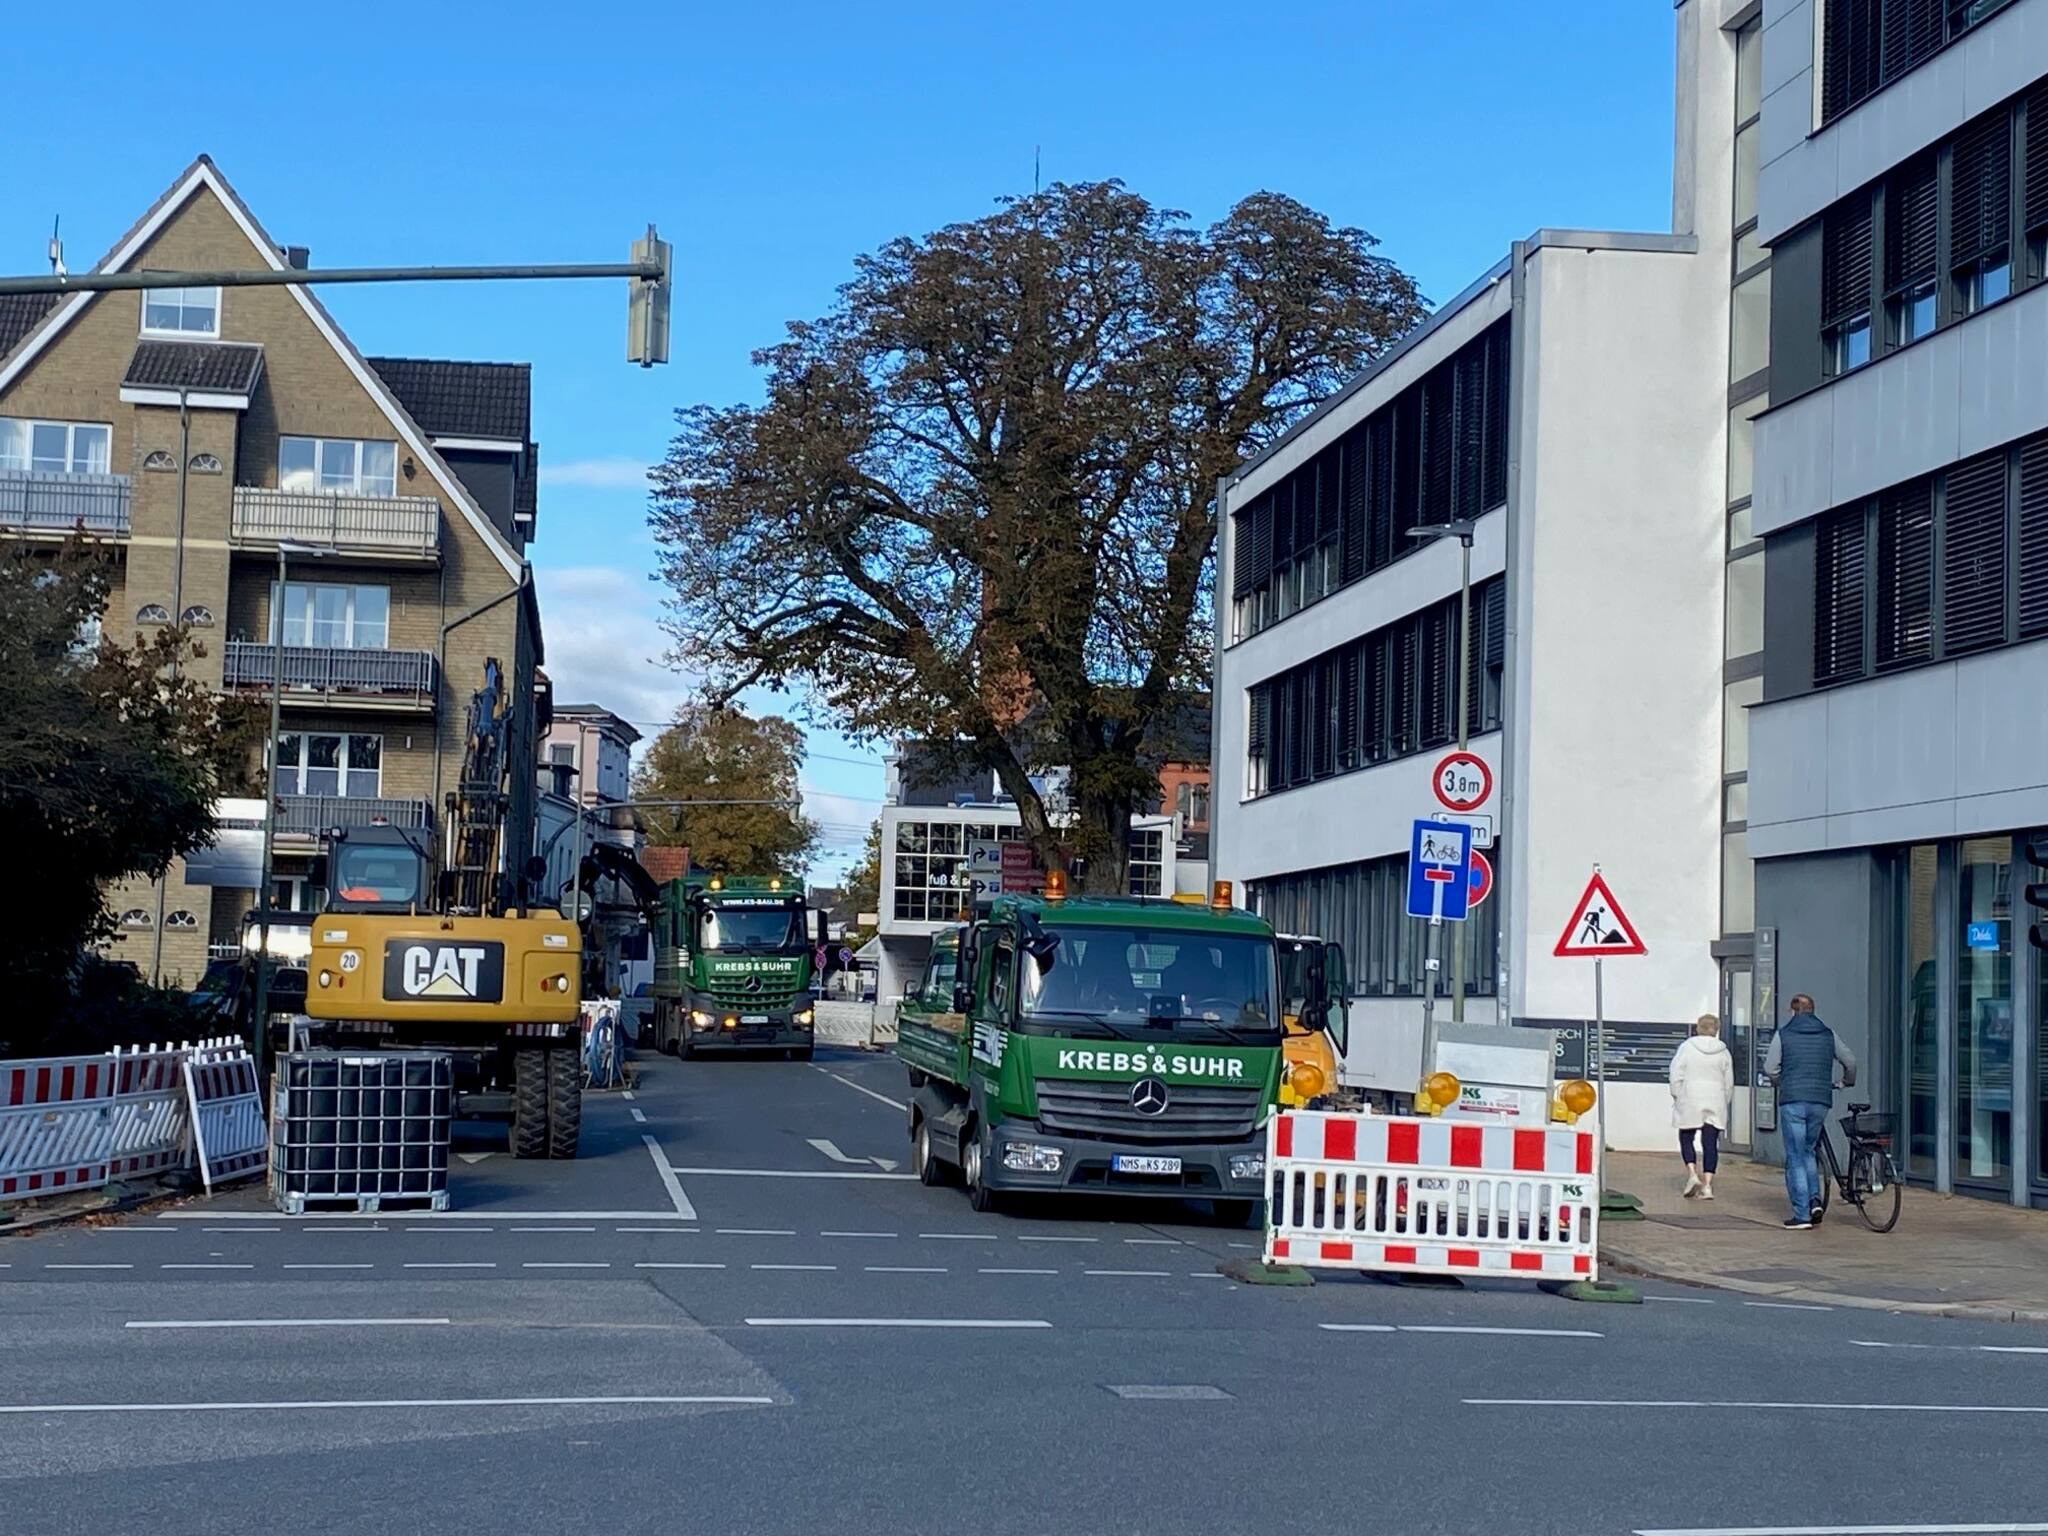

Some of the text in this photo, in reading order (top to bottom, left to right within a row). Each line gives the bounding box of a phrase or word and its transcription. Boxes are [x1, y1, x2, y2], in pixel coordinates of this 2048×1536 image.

[343, 954, 356, 968] 20
[715, 961, 792, 972] KREBS & SUHR
[402, 946, 485, 996] CAT
[1059, 1050, 1243, 1078] KREBS & SUHR
[1120, 1158, 1180, 1172] NMS KS 289
[1562, 1184, 1583, 1197] KS
